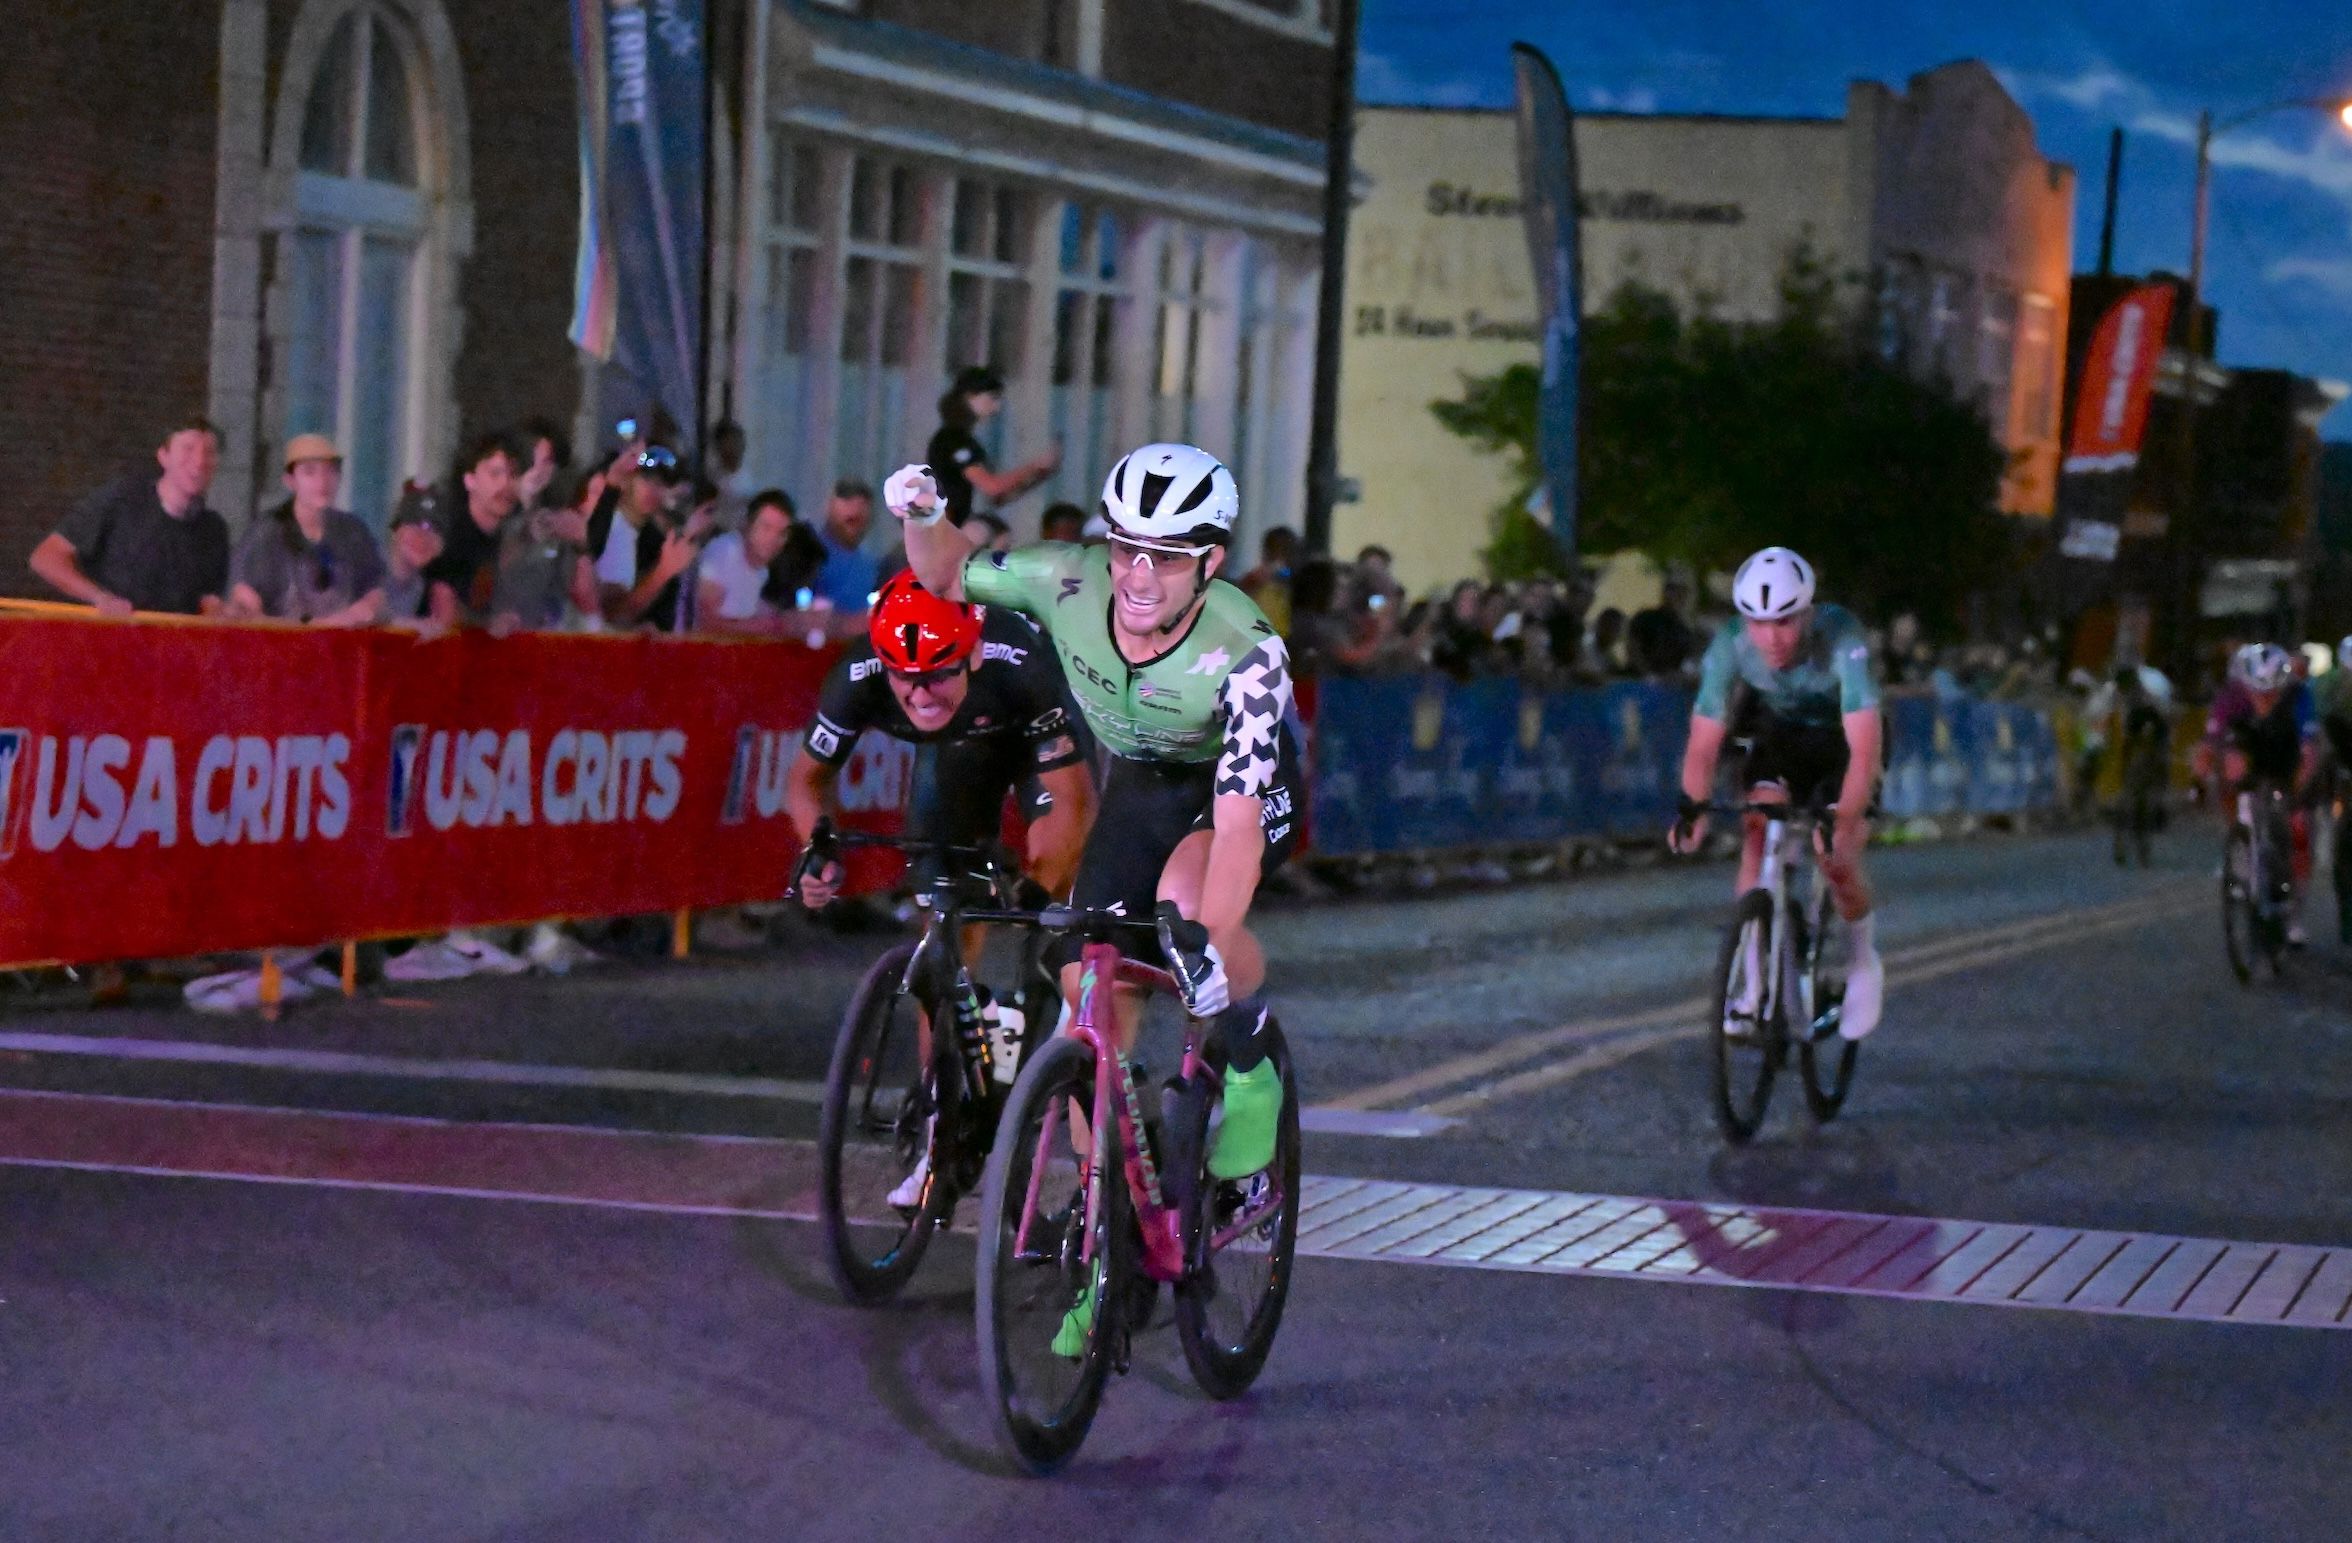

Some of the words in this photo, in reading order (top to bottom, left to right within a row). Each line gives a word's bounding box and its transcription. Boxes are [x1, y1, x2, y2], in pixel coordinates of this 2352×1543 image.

[982, 641, 1029, 666] BMC
[1072, 655, 1118, 695] CEC
[30, 733, 178, 851] USA
[191, 732, 350, 847] CRITS
[425, 728, 534, 831] USA
[541, 727, 688, 827] CRITS
